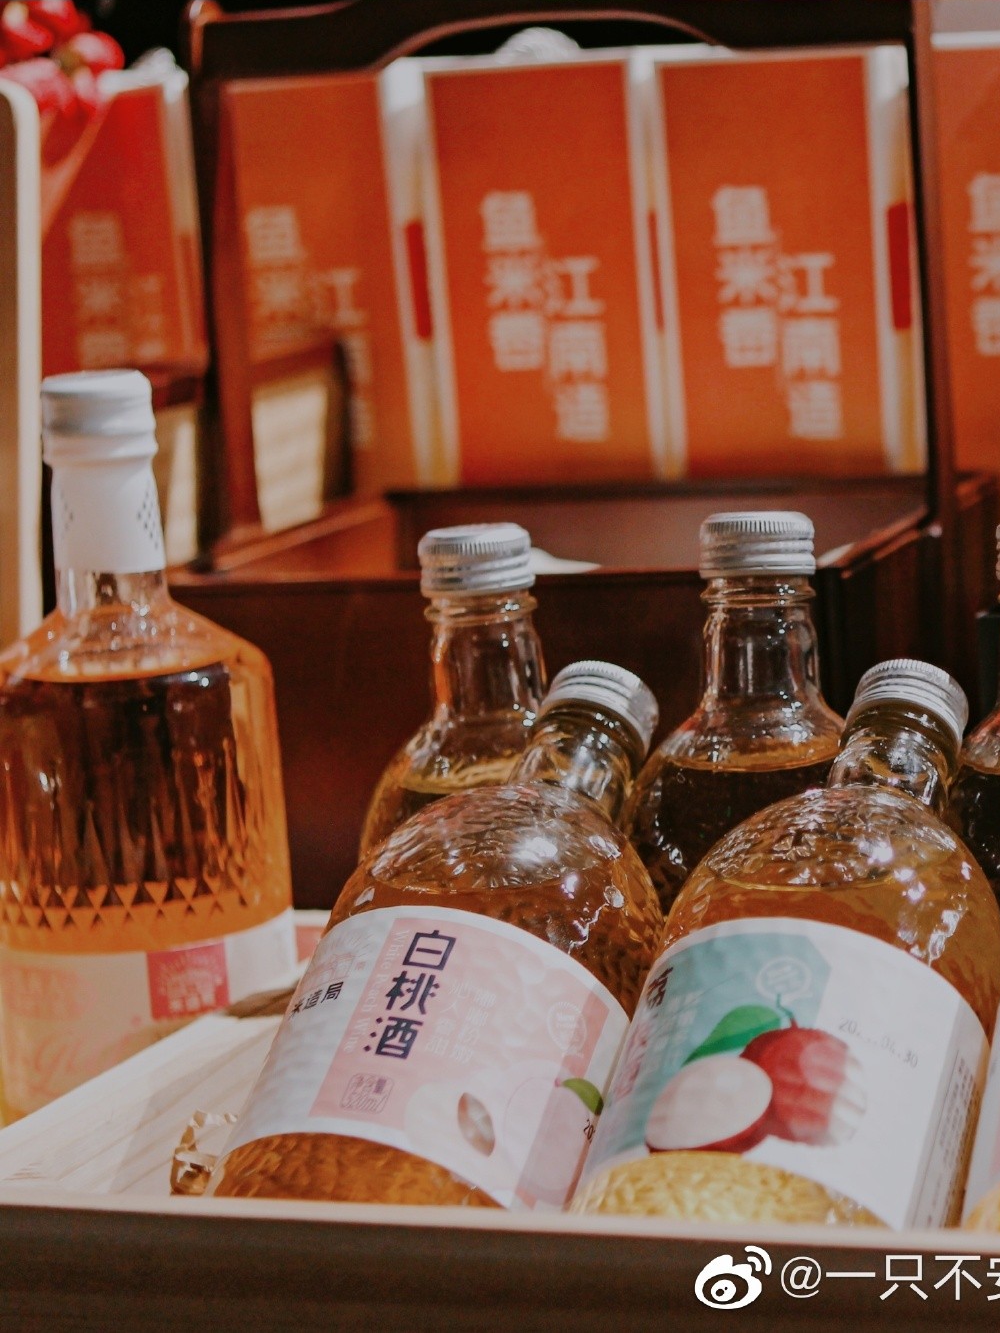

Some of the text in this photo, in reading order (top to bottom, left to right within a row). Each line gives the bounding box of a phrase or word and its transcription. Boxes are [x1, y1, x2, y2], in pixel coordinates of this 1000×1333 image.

[712, 185, 780, 368] 鱼米香
[779, 253, 843, 440] 江南造
[363, 929, 457, 1060] 白桃酒
